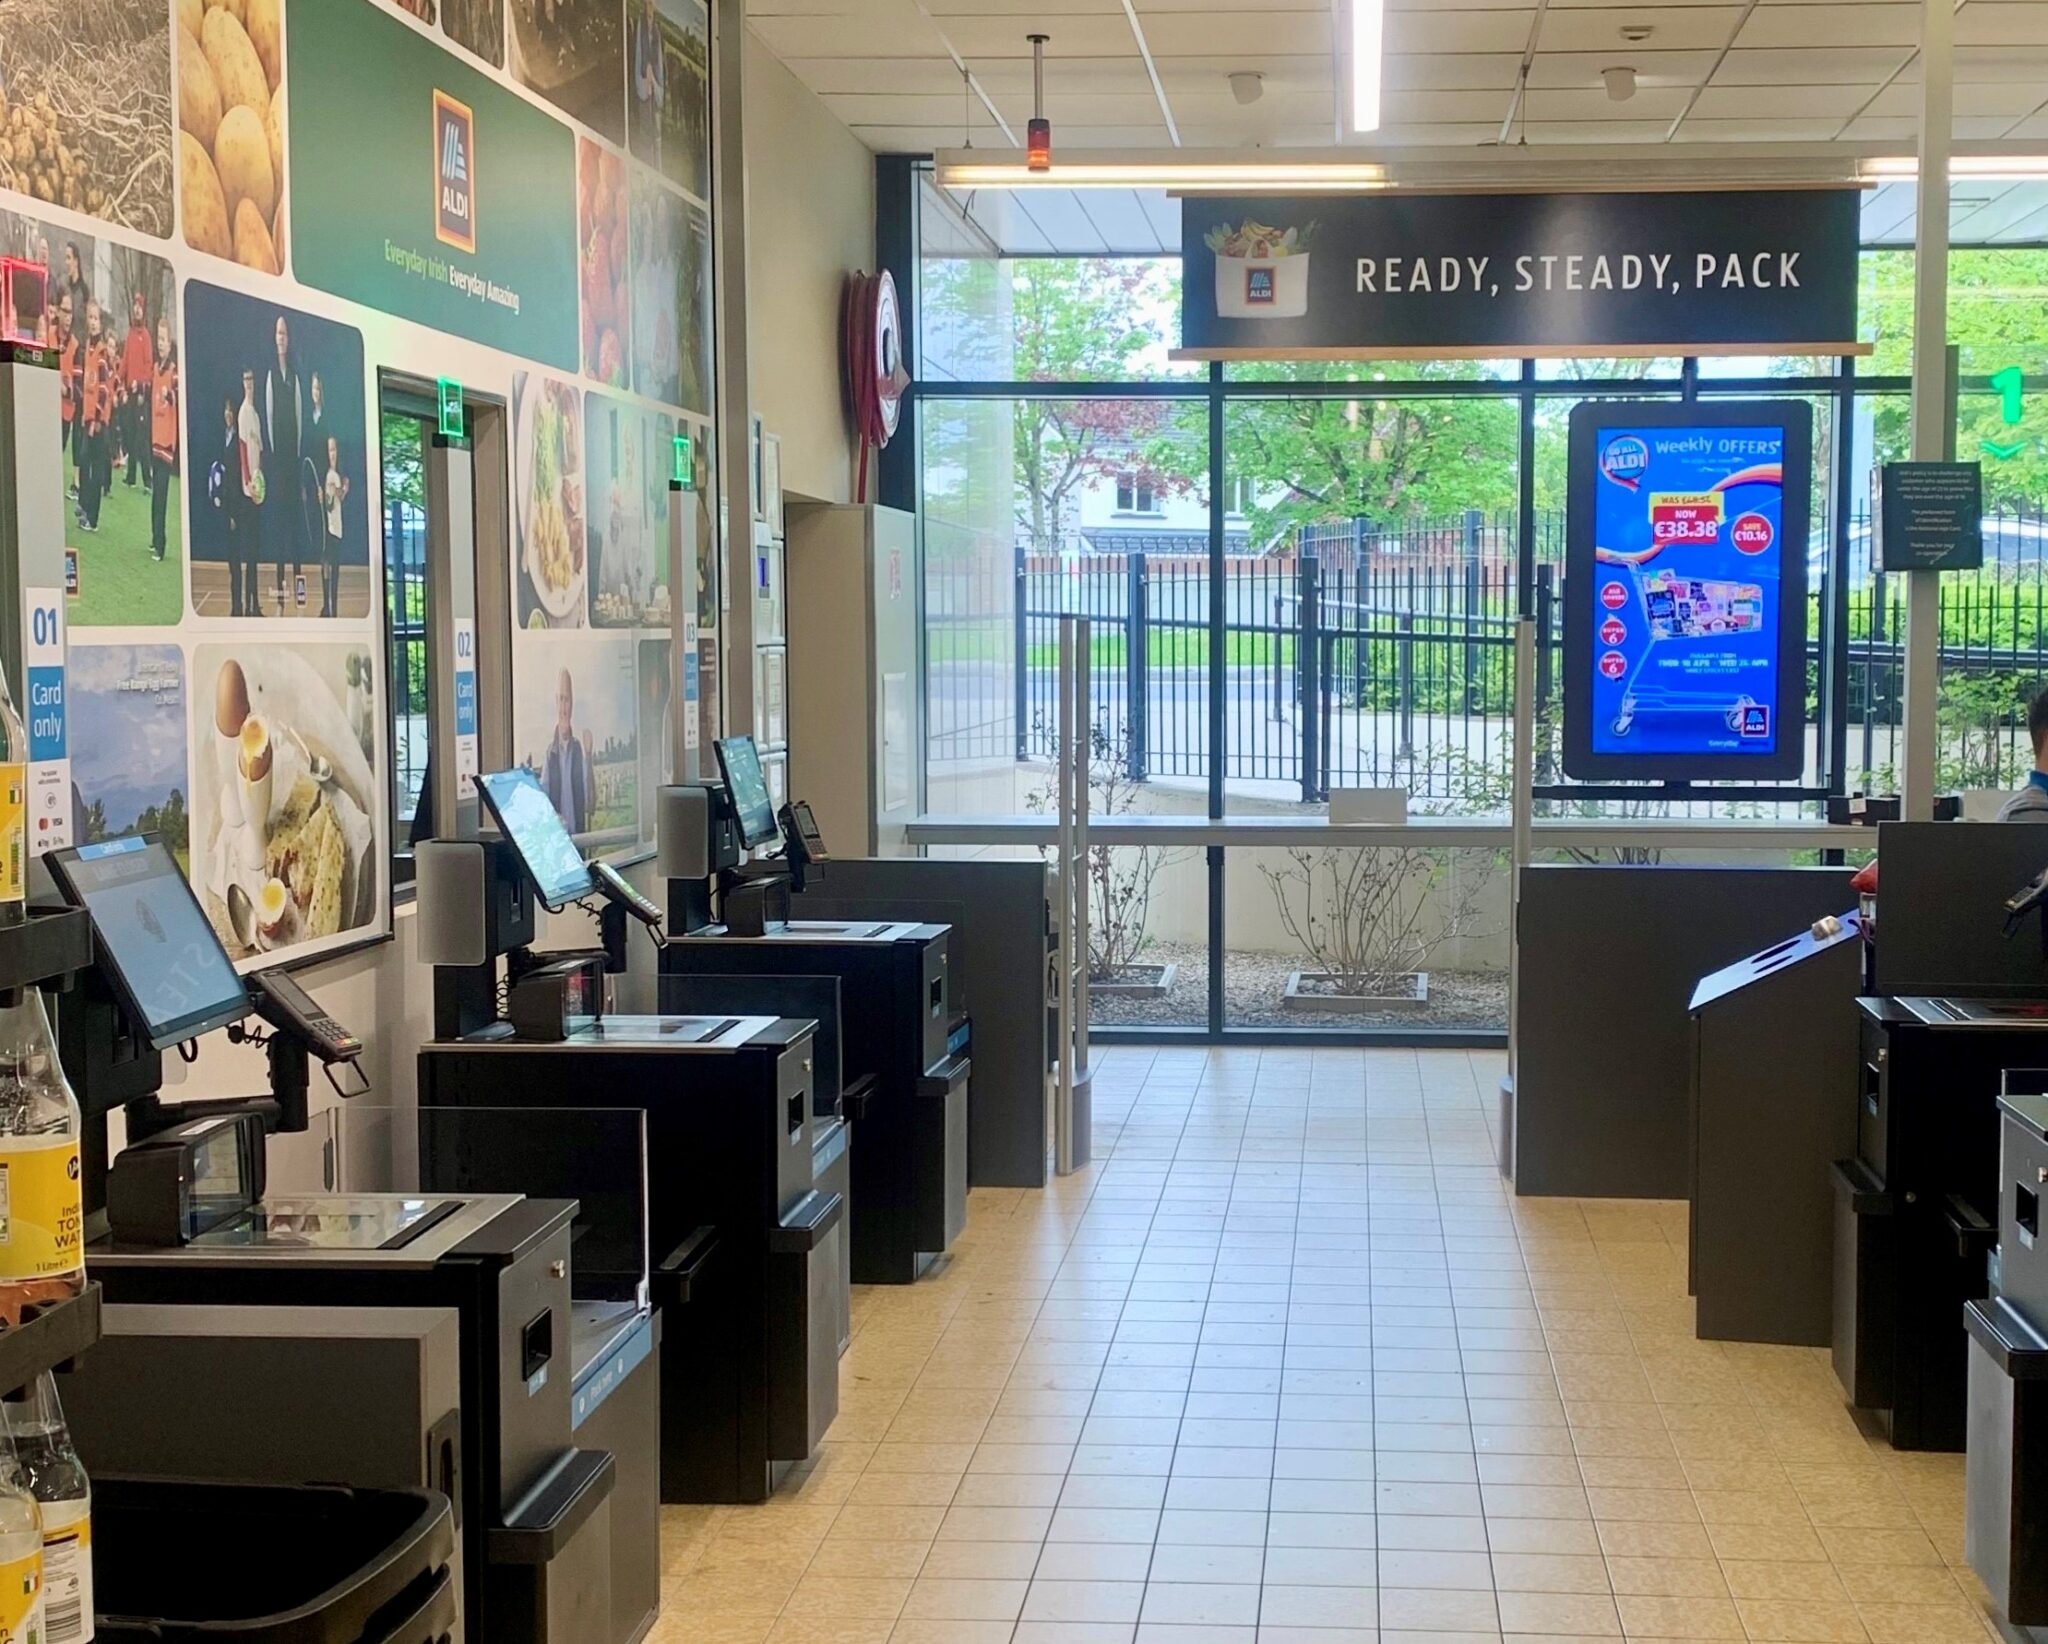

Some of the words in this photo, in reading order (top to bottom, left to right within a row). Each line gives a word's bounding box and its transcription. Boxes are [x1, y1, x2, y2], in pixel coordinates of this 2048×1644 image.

[442, 186, 469, 220] ALDI
[384, 238, 428, 281] Everyday
[428, 256, 449, 284] Irish
[449, 264, 487, 303] Everyday
[487, 279, 520, 316] Amazing
[1356, 255, 1500, 299] READY,
[1514, 254, 1681, 296] STEADY,
[1696, 251, 1802, 289] PACK
[1250, 289, 1272, 298] ALDI
[1991, 366, 2022, 425] 1
[1655, 437, 1713, 455] Weekly
[1719, 439, 1779, 455] OFFERS
[1606, 453, 1646, 470] ALDI
[1675, 509, 1697, 519] NOW
[1654, 520, 1718, 538] €38.38
[1734, 530, 1769, 541] €10.16
[33, 607, 58, 646] 01
[457, 631, 472, 658] 02
[1608, 633, 1618, 645] 6
[1608, 663, 1618, 674] 6
[32, 680, 62, 706] Card
[34, 712, 62, 743] only
[36, 1263, 41, 1272] 1
[42, 1260, 59, 1272] Litre
